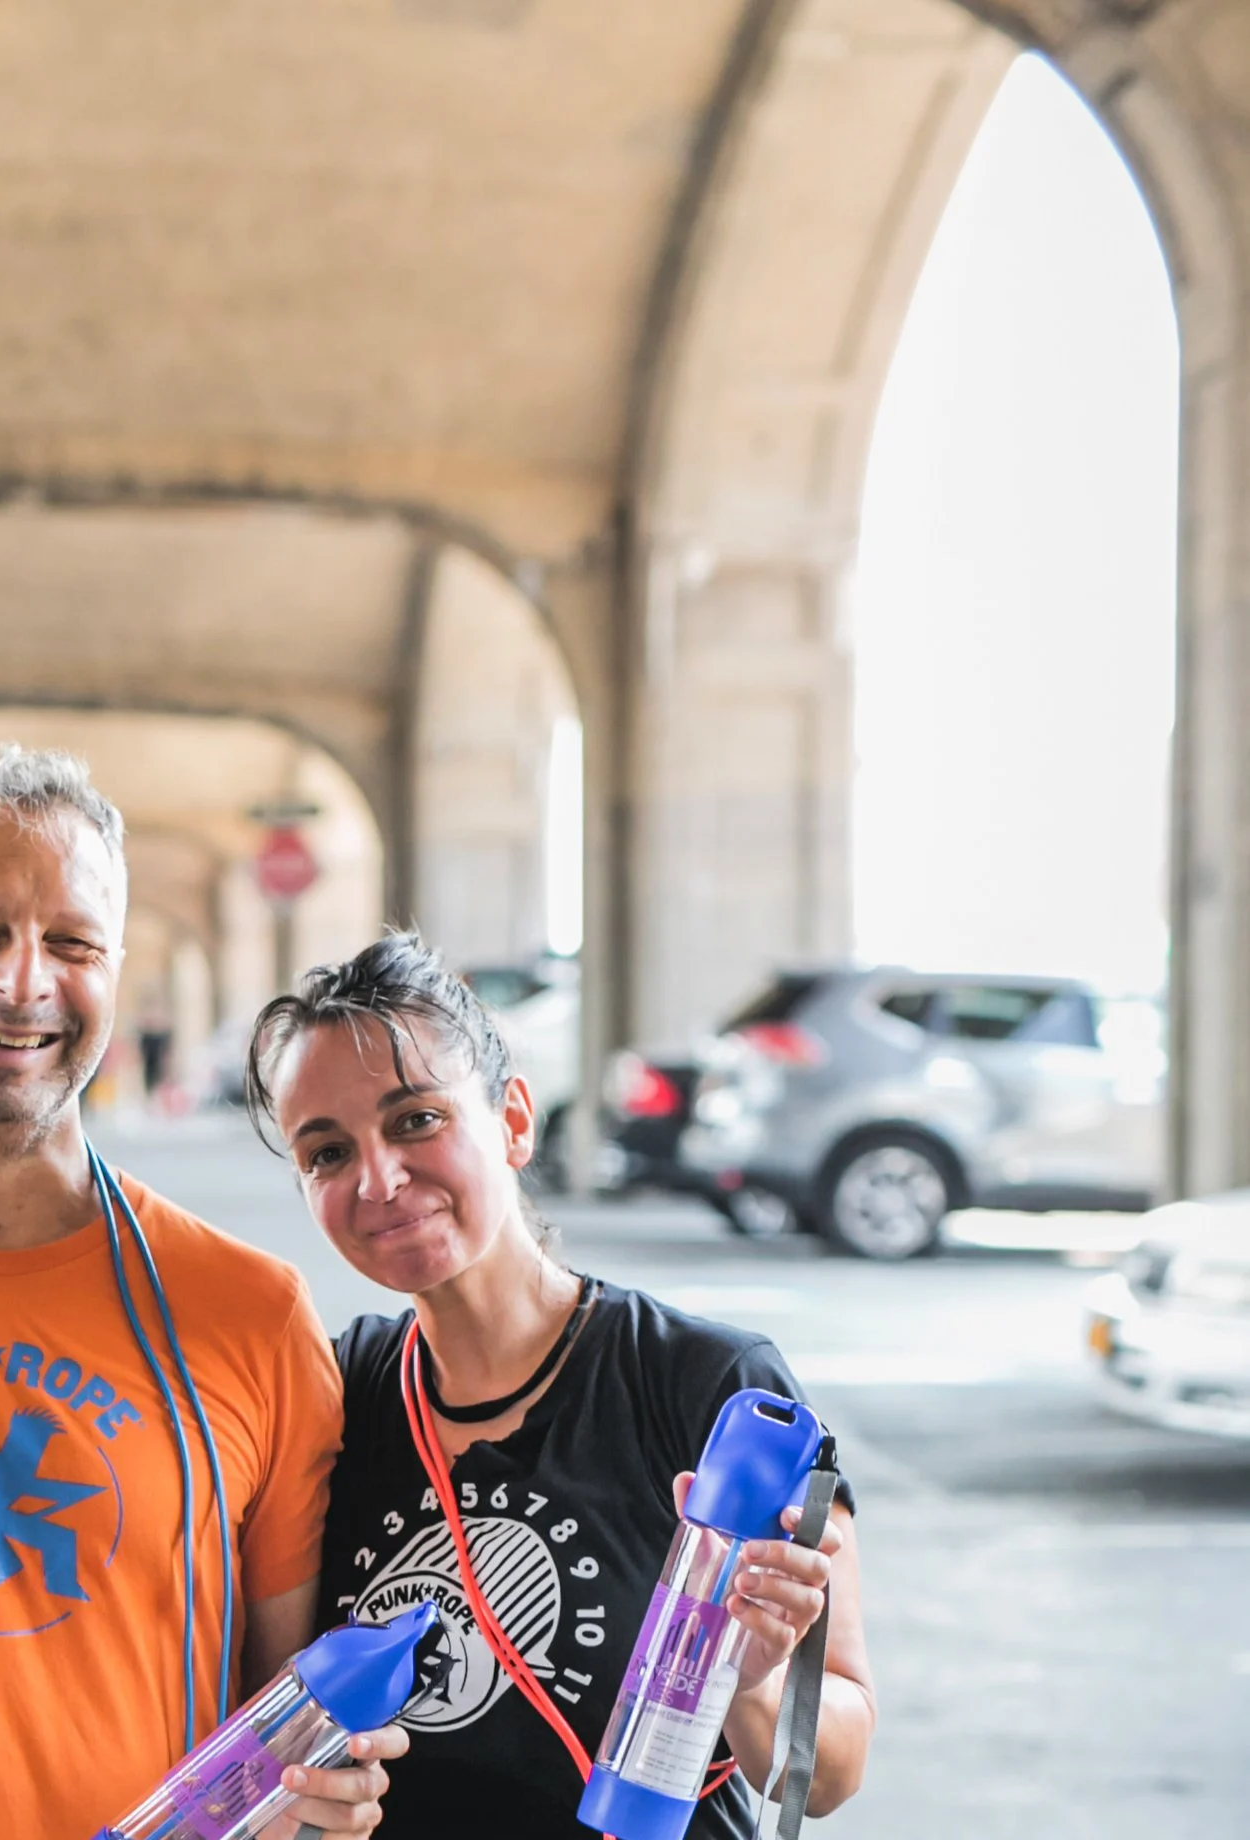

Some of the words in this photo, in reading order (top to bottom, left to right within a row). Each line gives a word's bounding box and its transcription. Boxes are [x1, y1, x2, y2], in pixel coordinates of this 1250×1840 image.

[4, 1341, 142, 1440] ROPE
[419, 1487, 440, 1511] 4
[460, 1483, 478, 1509] 5
[490, 1483, 509, 1509] 6
[524, 1492, 549, 1517] 7
[383, 1511, 405, 1535] 3
[549, 1518, 579, 1543] 8
[354, 1547, 377, 1571] 2
[569, 1556, 599, 1580] 9
[366, 1582, 425, 1621] PUNK
[432, 1584, 477, 1637] ROPE
[574, 1605, 605, 1647] 10
[553, 1667, 593, 1705] 11
